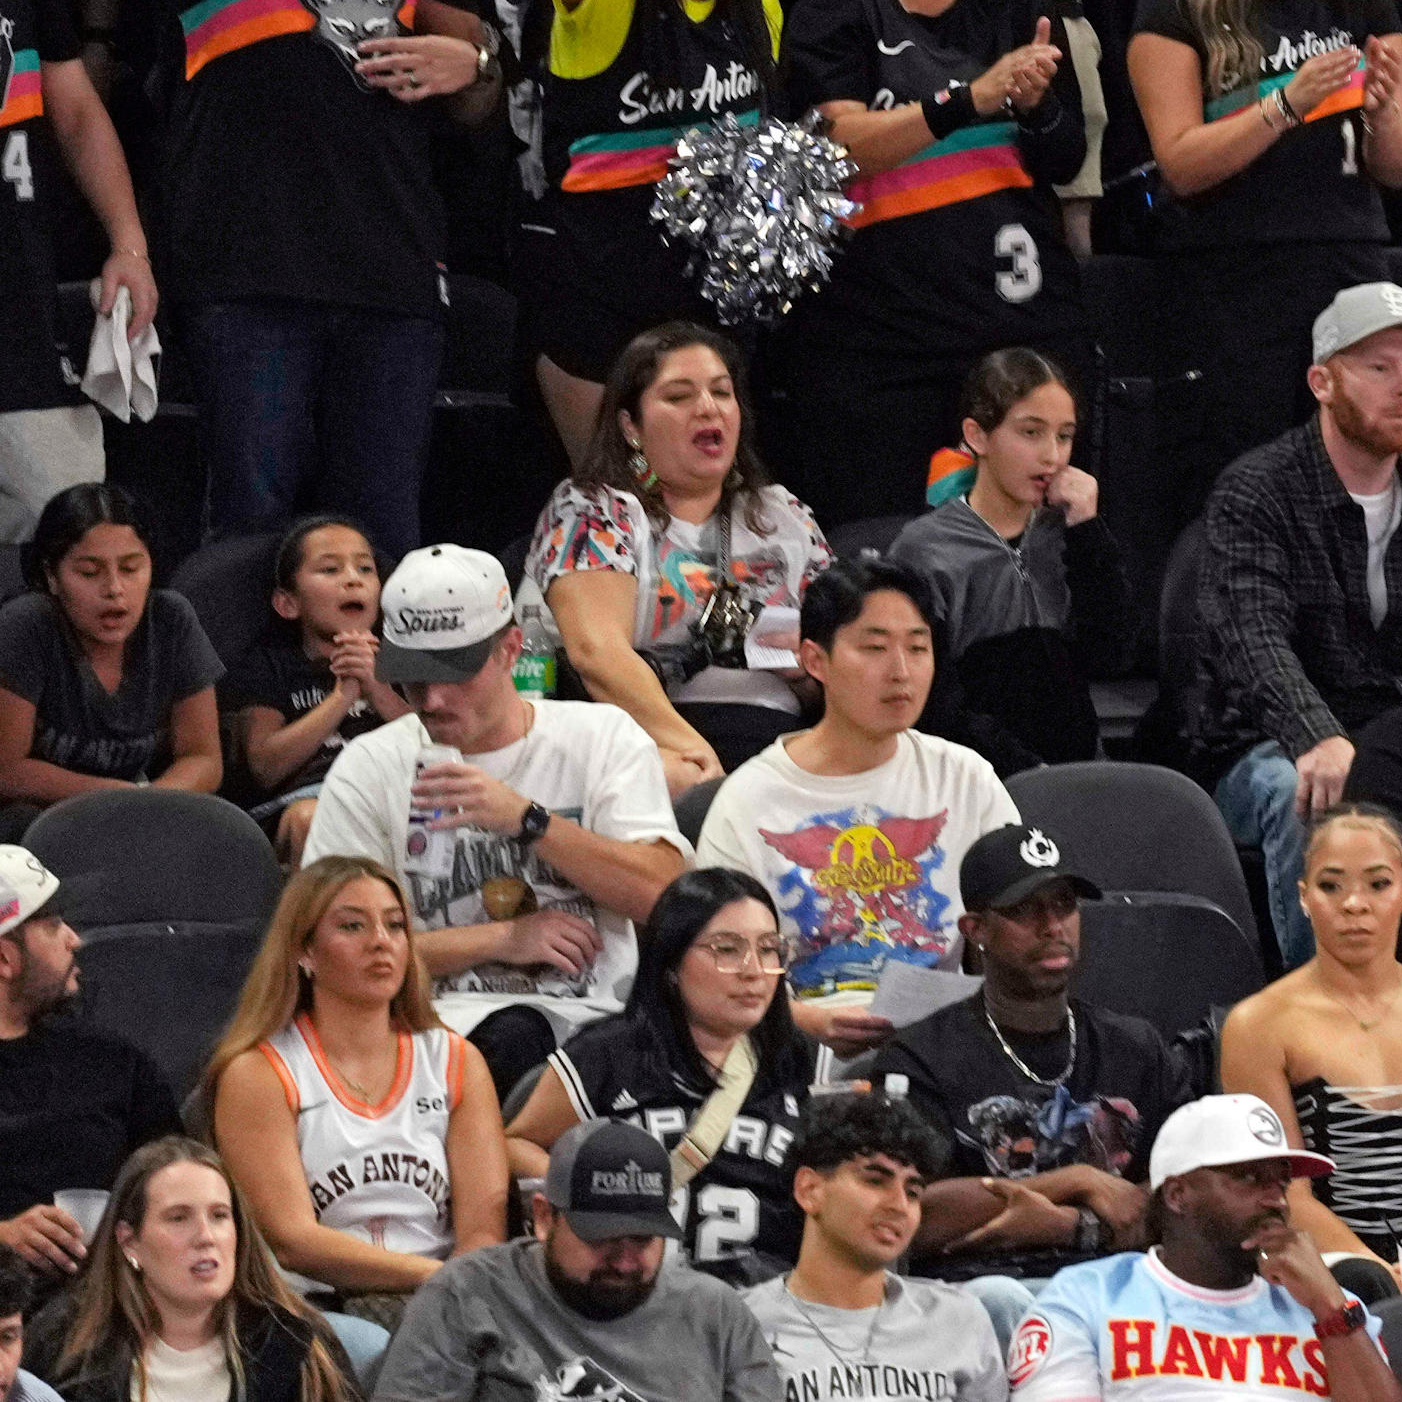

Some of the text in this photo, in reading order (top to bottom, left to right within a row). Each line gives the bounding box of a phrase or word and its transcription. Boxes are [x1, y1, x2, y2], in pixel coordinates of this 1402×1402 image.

[618, 70, 685, 126] San
[2, 129, 34, 200] 4
[993, 222, 1043, 303] 3
[394, 607, 463, 635] Spurs
[786, 1364, 948, 1402] AN ANTONIO
[1107, 1318, 1332, 1399] HAWKS
